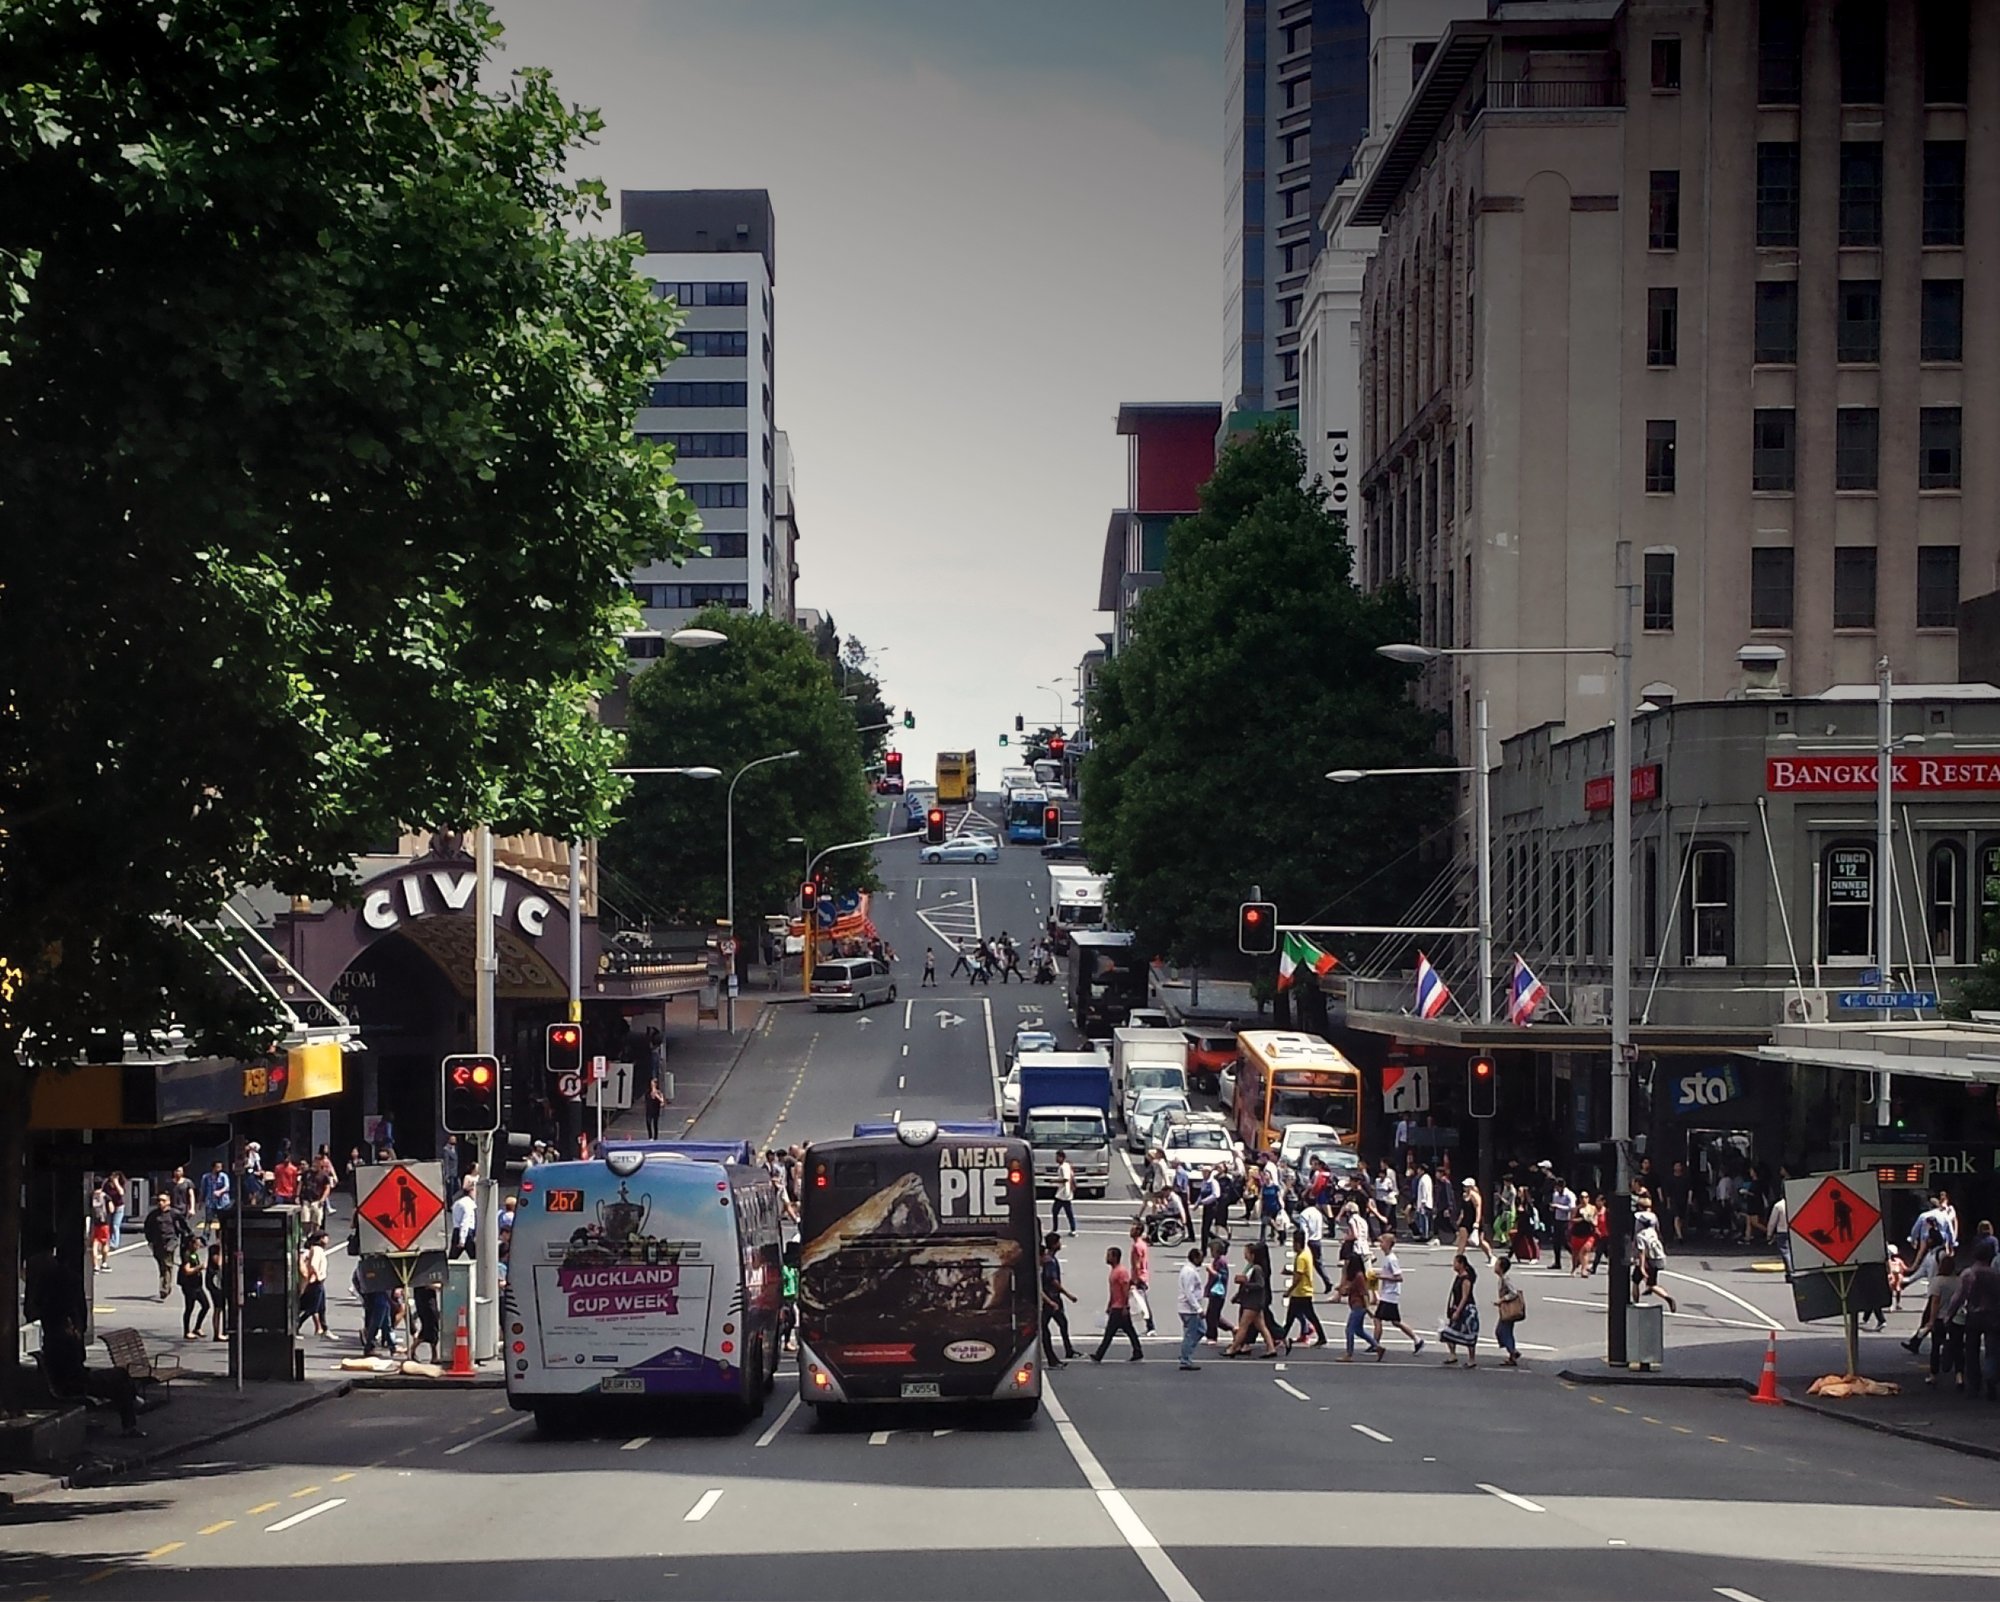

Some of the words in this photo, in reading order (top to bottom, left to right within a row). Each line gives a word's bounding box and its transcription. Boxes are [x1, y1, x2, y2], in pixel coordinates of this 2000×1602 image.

[1831, 881, 1868, 890] DINNER
[363, 871, 550, 936] CIVIC
[1866, 994, 1898, 1006] QUEEN
[1679, 1072, 1727, 1104] sta
[940, 1148, 952, 1168] A
[957, 1147, 1008, 1168] MEAT
[1929, 1150, 1977, 1174] ank
[549, 1190, 578, 1211] 267
[940, 1168, 1010, 1216] PIE
[571, 1269, 673, 1288] AUCKLAND
[573, 1298, 610, 1313] CUP
[614, 1294, 669, 1311] WEEK
